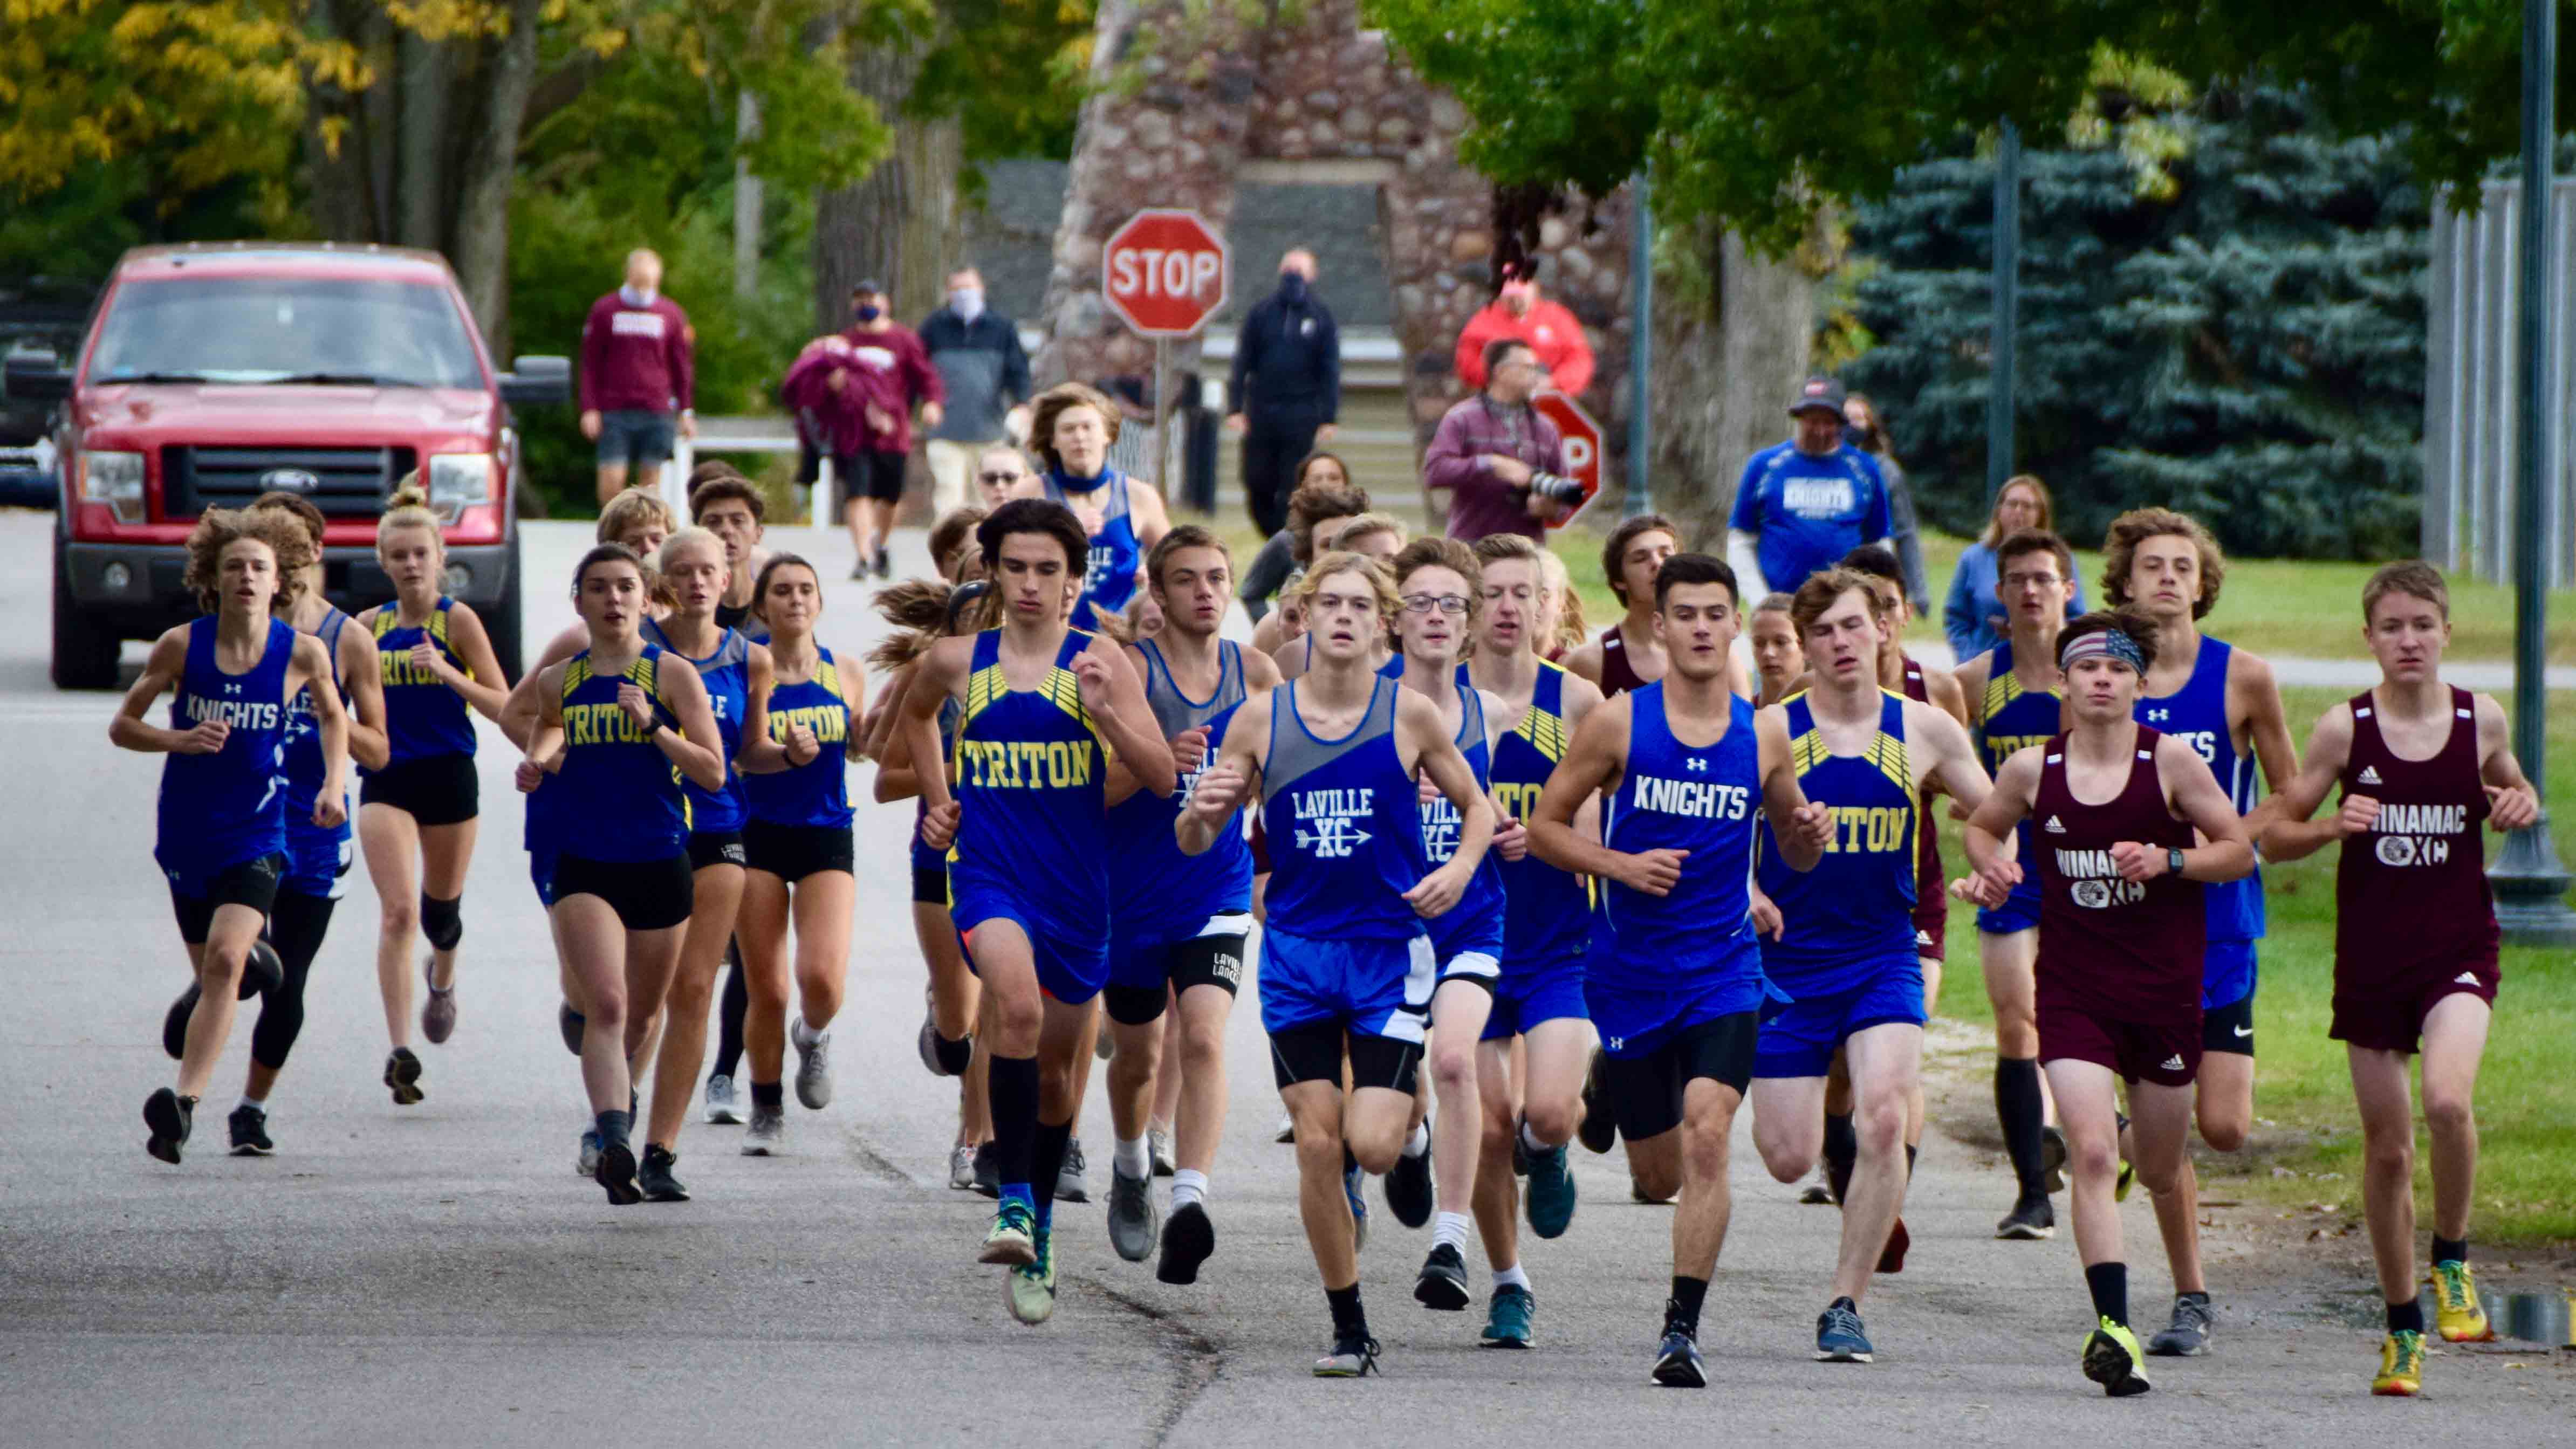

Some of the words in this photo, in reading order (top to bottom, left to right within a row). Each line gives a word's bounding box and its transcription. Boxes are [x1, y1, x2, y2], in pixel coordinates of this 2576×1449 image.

[1113, 249, 1218, 298] STOP
[186, 692, 279, 730] KNIGHTS
[964, 740, 1092, 788] TRITON
[1292, 788, 1373, 819] LAVILLE
[1421, 797, 1462, 824] VILL
[1633, 774, 1749, 820] KNIGHTS
[1314, 817, 1353, 857] XC
[1825, 807, 1909, 853] ITON
[2371, 804, 2467, 834] INAMAC
[2055, 848, 2118, 878] WINA
